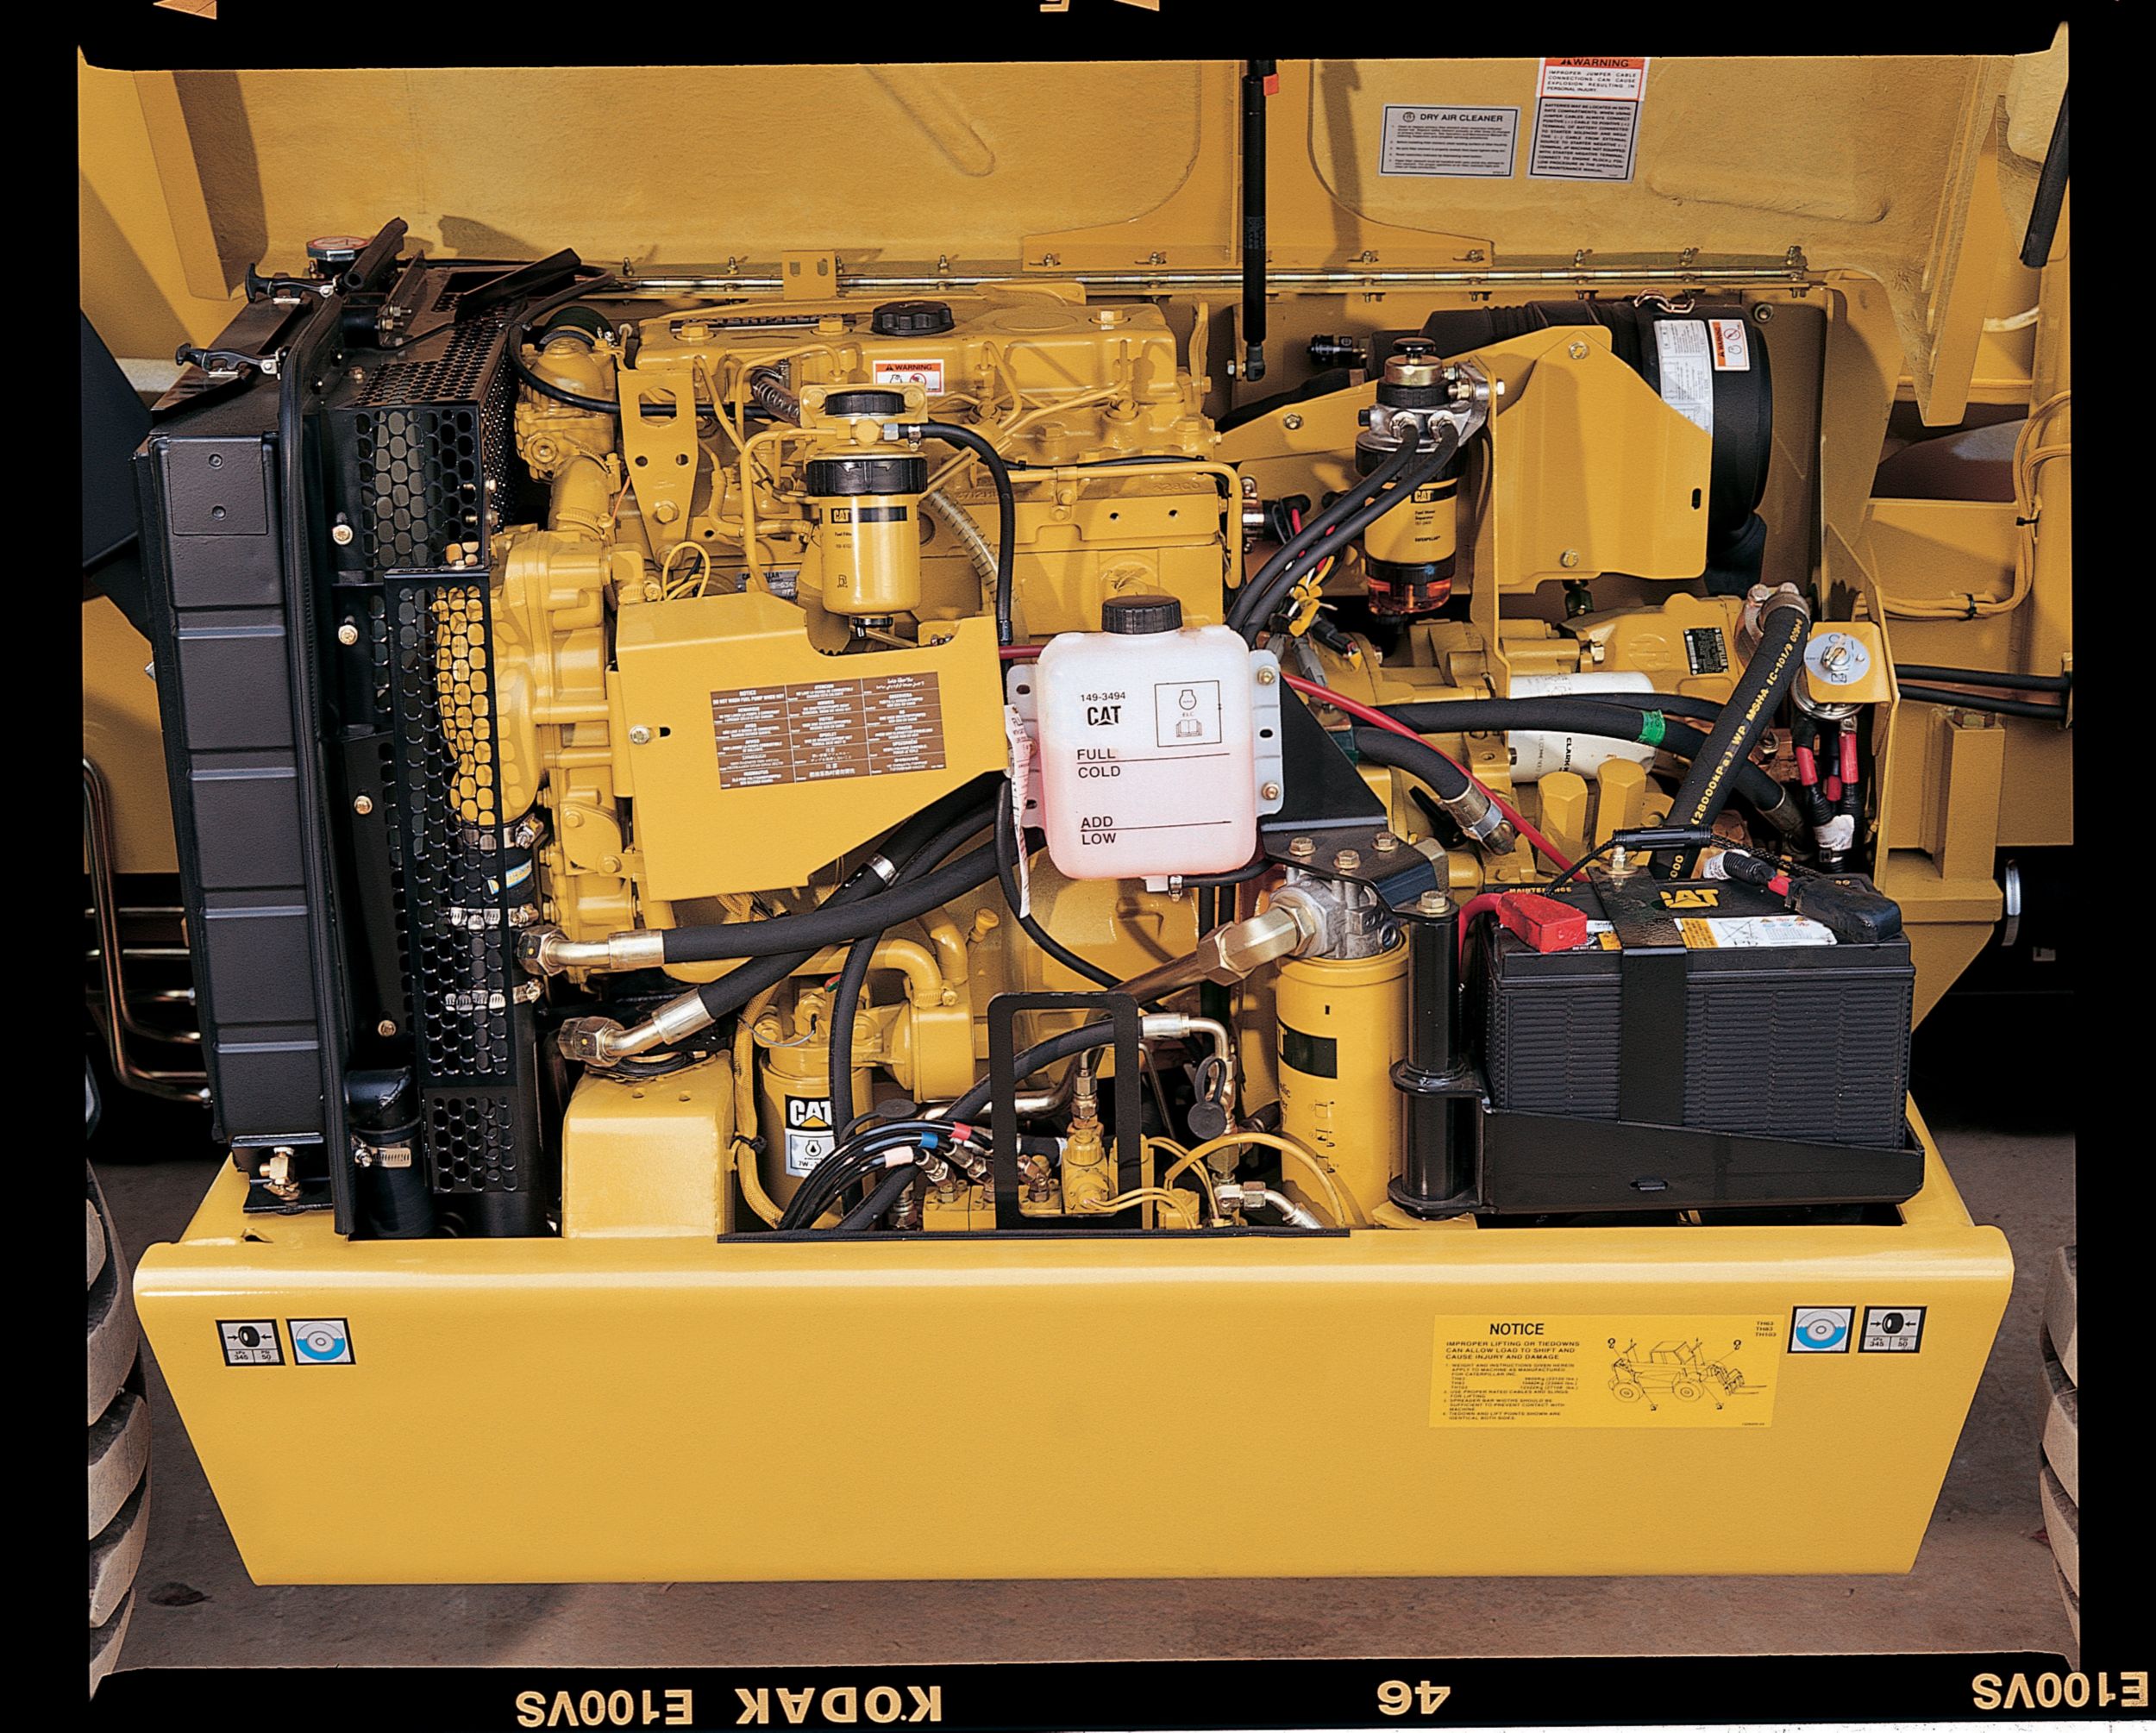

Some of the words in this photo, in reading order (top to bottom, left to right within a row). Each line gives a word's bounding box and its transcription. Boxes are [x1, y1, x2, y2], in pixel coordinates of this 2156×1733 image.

[1573, 58, 1629, 67] WARNING
[1458, 114, 1503, 122] CLEANER
[1414, 491, 1432, 502] CAT
[834, 510, 849, 522] CAT
[1081, 691, 1126, 702] 149-3494
[1731, 725, 1747, 747] WP
[1745, 687, 1770, 722] MSHA
[1766, 643, 1793, 686] IC-101/9
[1087, 705, 1122, 726] CAT
[1076, 748, 1117, 760] FULL
[1564, 736, 1572, 766] CLARK
[1077, 765, 1121, 779] COLD
[1081, 816, 1113, 829] ADD
[1081, 832, 1117, 846] LOW
[1659, 889, 1720, 909] CAT
[789, 1099, 832, 1127] CAT
[1489, 1322, 1545, 1336] NOTICE
[1377, 1680, 1451, 1715] 46
[1971, 1671, 2149, 1711] E100VS
[516, 1689, 693, 1728] E100VS
[735, 1686, 942, 1724] KODAK
